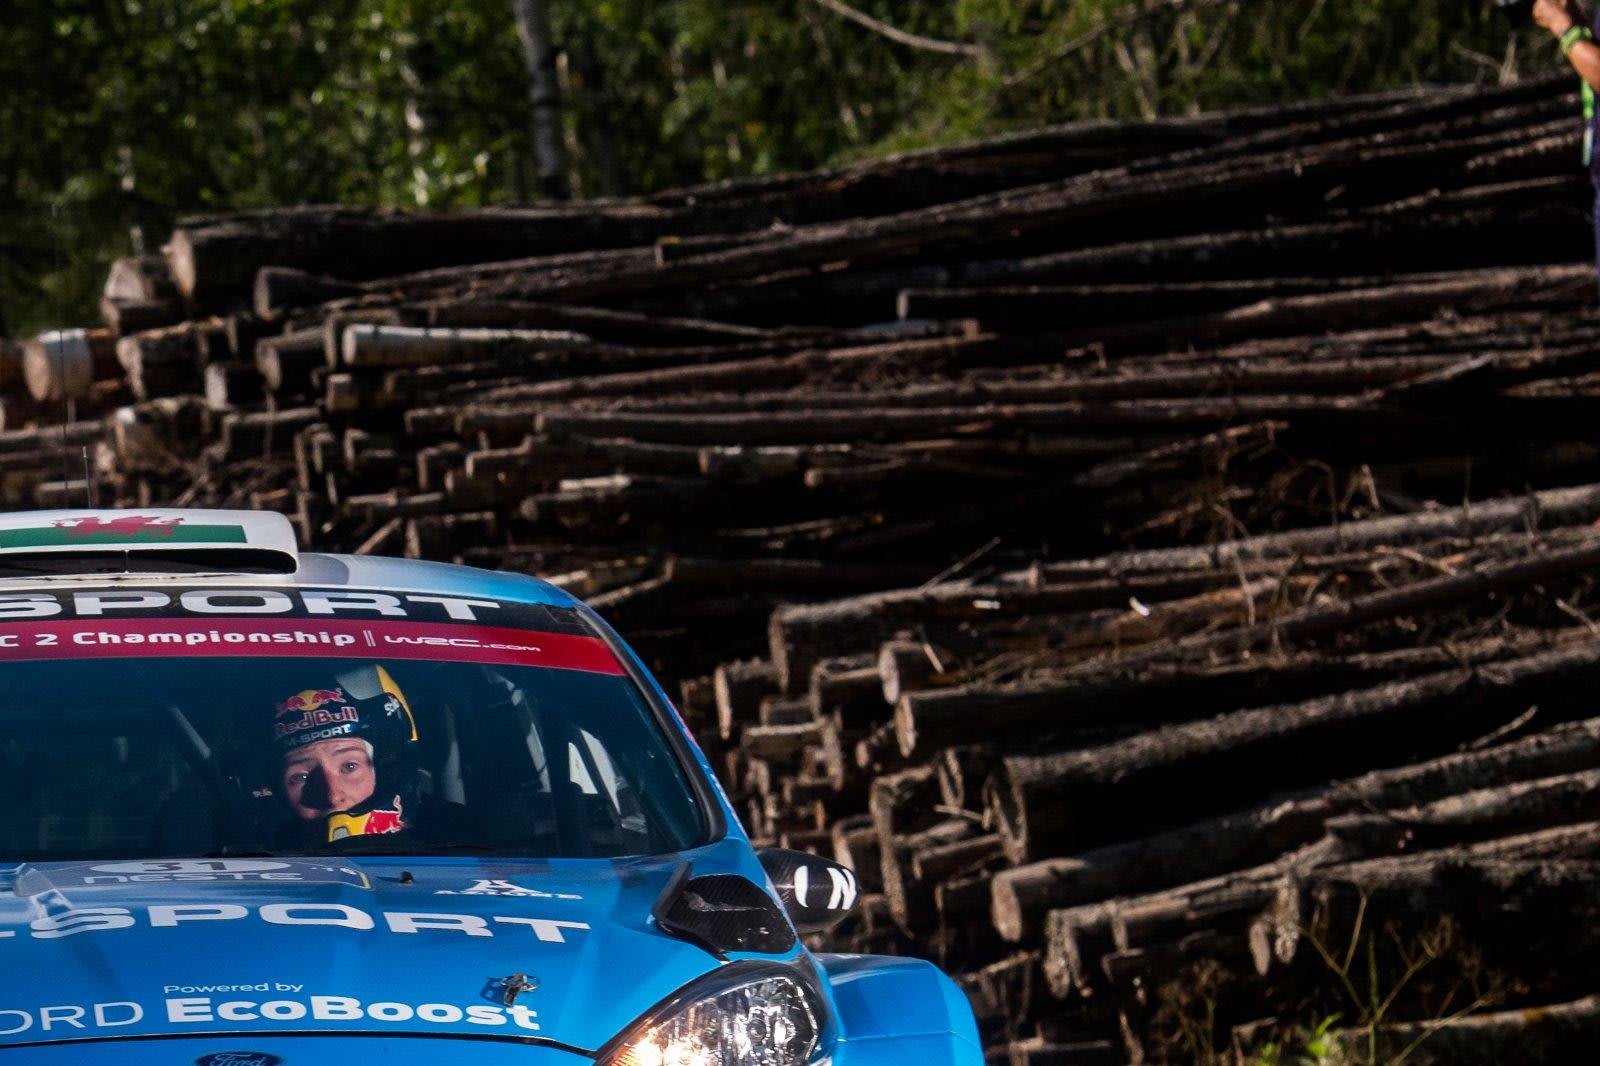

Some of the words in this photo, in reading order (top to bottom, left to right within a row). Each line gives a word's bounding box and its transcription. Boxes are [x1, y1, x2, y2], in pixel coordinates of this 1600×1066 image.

[34, 633, 58, 646] 2
[73, 630, 356, 646] Championship
[274, 712, 314, 738] Red
[314, 706, 359, 727] Bull
[142, 861, 228, 872] 31
[83, 872, 303, 884] NESTE
[163, 983, 269, 994] Powered
[275, 982, 303, 993] by
[166, 996, 540, 1030] EcoBoost
